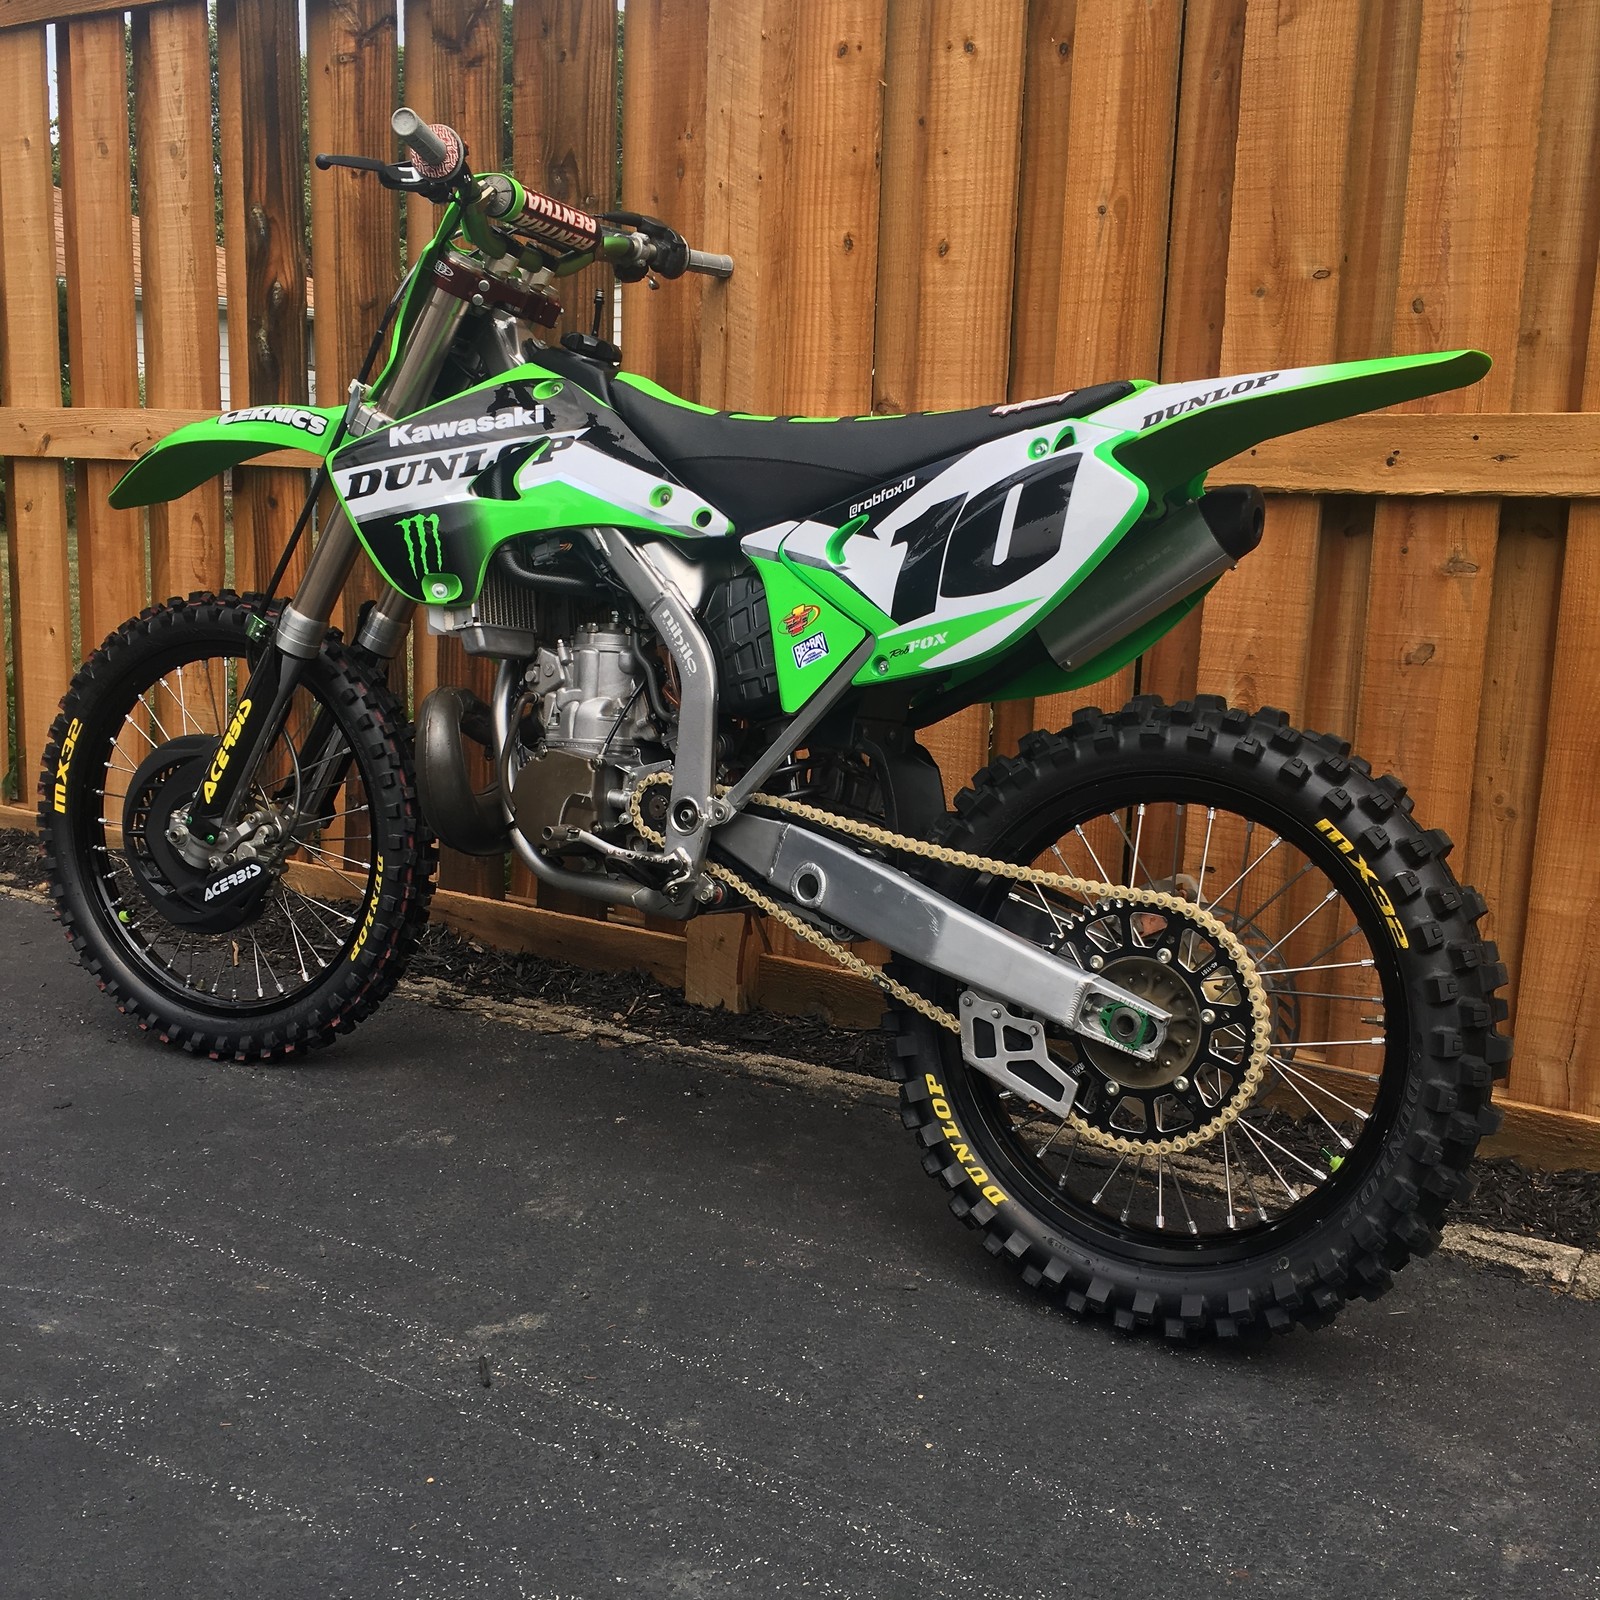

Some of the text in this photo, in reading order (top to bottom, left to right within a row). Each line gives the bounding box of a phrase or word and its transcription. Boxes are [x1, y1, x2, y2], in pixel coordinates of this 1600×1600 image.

[523, 190, 597, 234] RENTHA
[389, 404, 545, 448] Kawasaki
[1140, 373, 1279, 430] DUNLOP
[849, 475, 916, 519] @robfox10
[890, 452, 1084, 627] 10
[662, 609, 697, 673] nihilo
[889, 631, 949, 658] Rob FOX
[54, 717, 83, 814] MX32
[350, 852, 384, 961] DUNLOP
[1314, 818, 1409, 949] MX32
[925, 1073, 1010, 1206] DUNLOP
